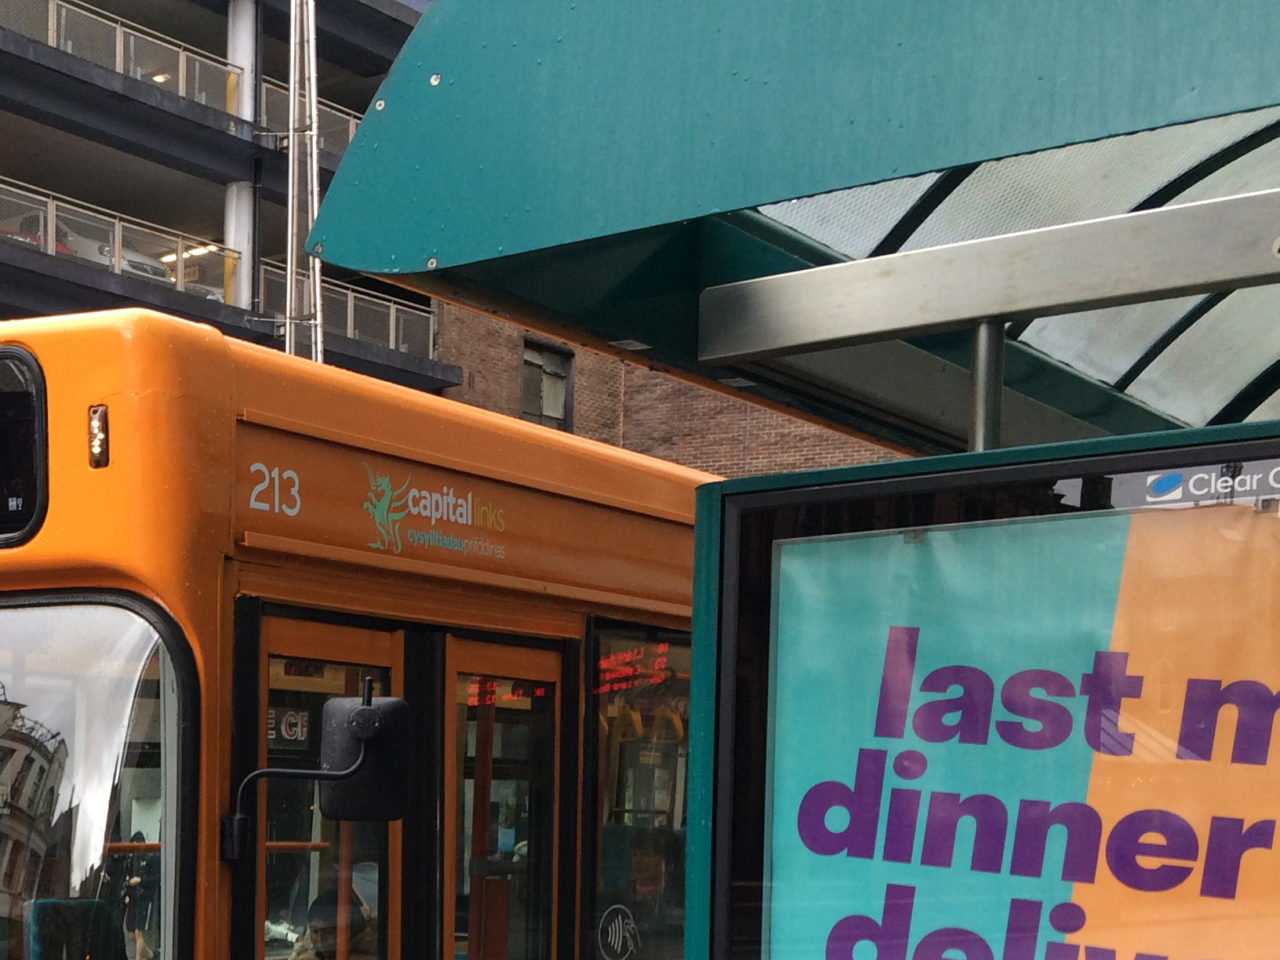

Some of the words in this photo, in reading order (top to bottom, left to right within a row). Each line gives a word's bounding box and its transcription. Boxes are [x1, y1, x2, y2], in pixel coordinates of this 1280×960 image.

[249, 462, 302, 517] 213
[1188, 472, 1263, 496] Clear
[874, 626, 1144, 757] last
[797, 748, 1276, 900] dinner
